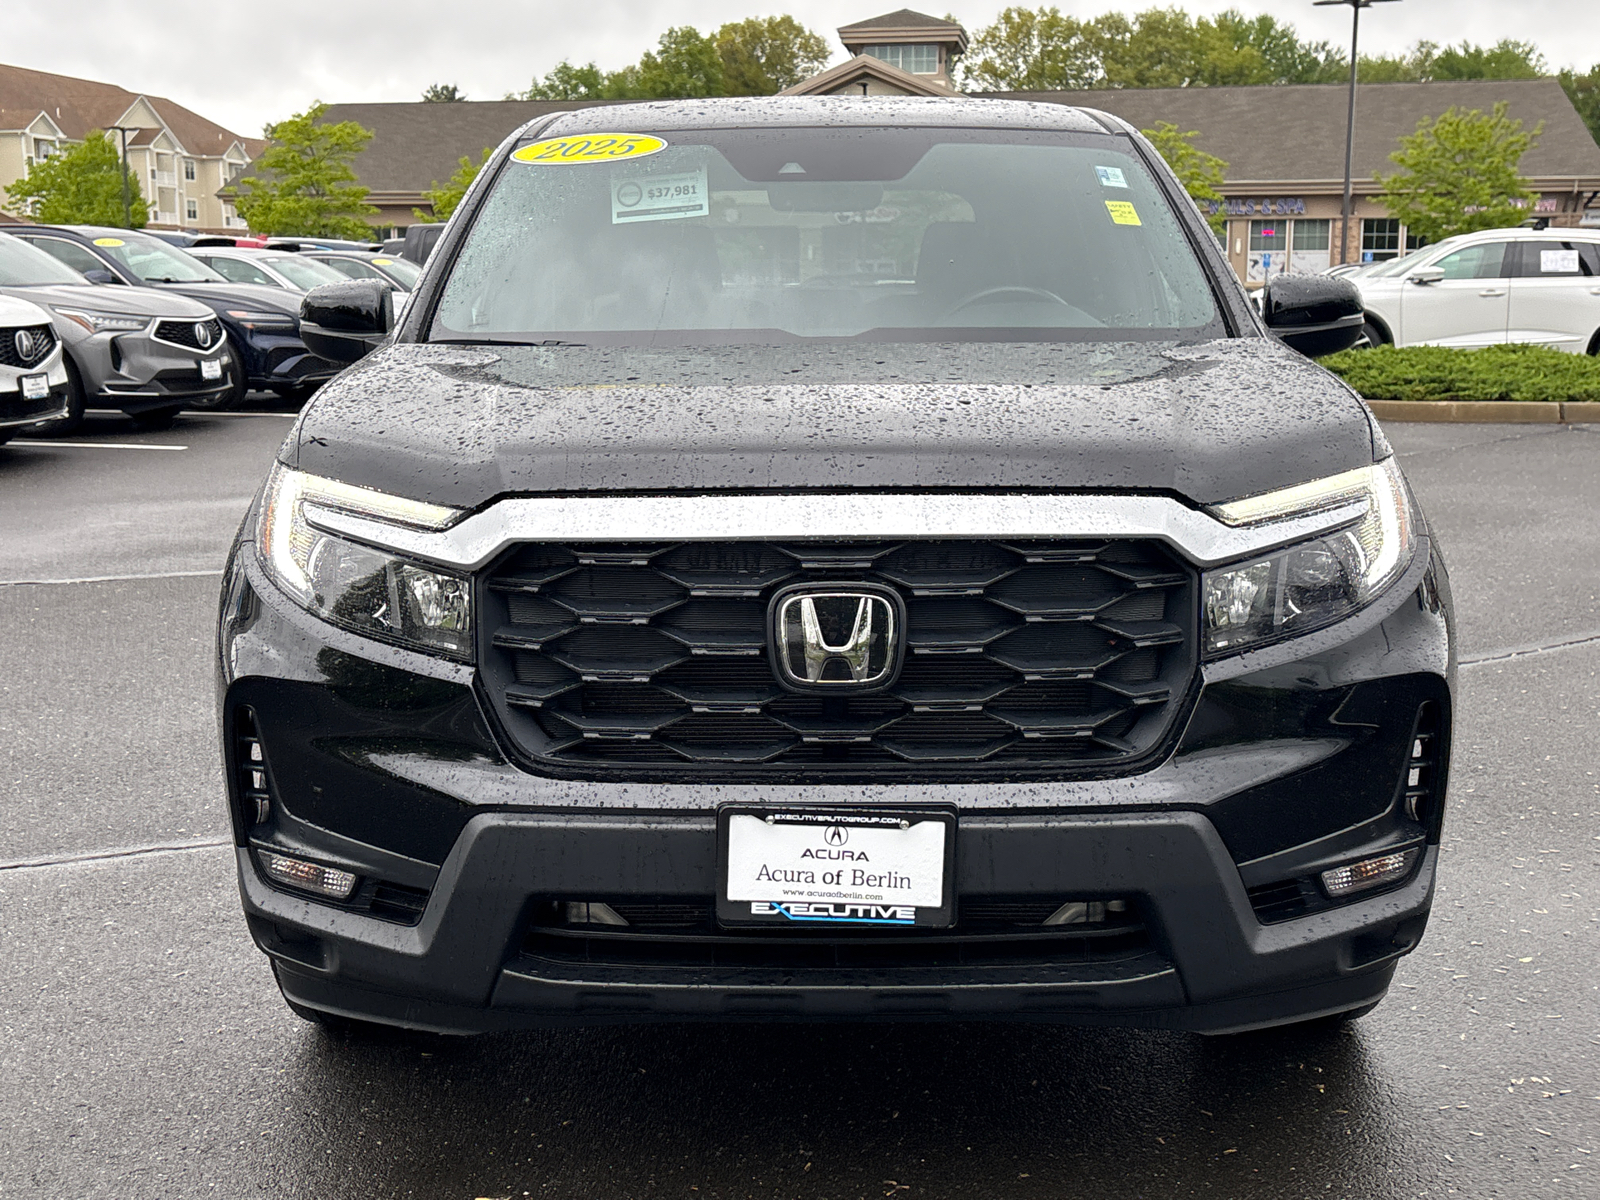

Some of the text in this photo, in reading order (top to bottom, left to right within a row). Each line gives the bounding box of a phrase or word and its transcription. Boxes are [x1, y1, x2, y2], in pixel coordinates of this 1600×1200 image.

[533, 138, 645, 160] 2025
[648, 185, 697, 200] $37,981
[1261, 198, 1271, 214] &
[1276, 198, 1305, 214] SPA
[774, 813, 901, 825] EXECUTIVEAUTOGROUP.COM
[800, 848, 870, 862] ACURA
[756, 863, 912, 890] Acura of Berlin
[782, 888, 883, 901] www.acuraofberlin.com
[750, 902, 916, 922] EXECUTIVE
